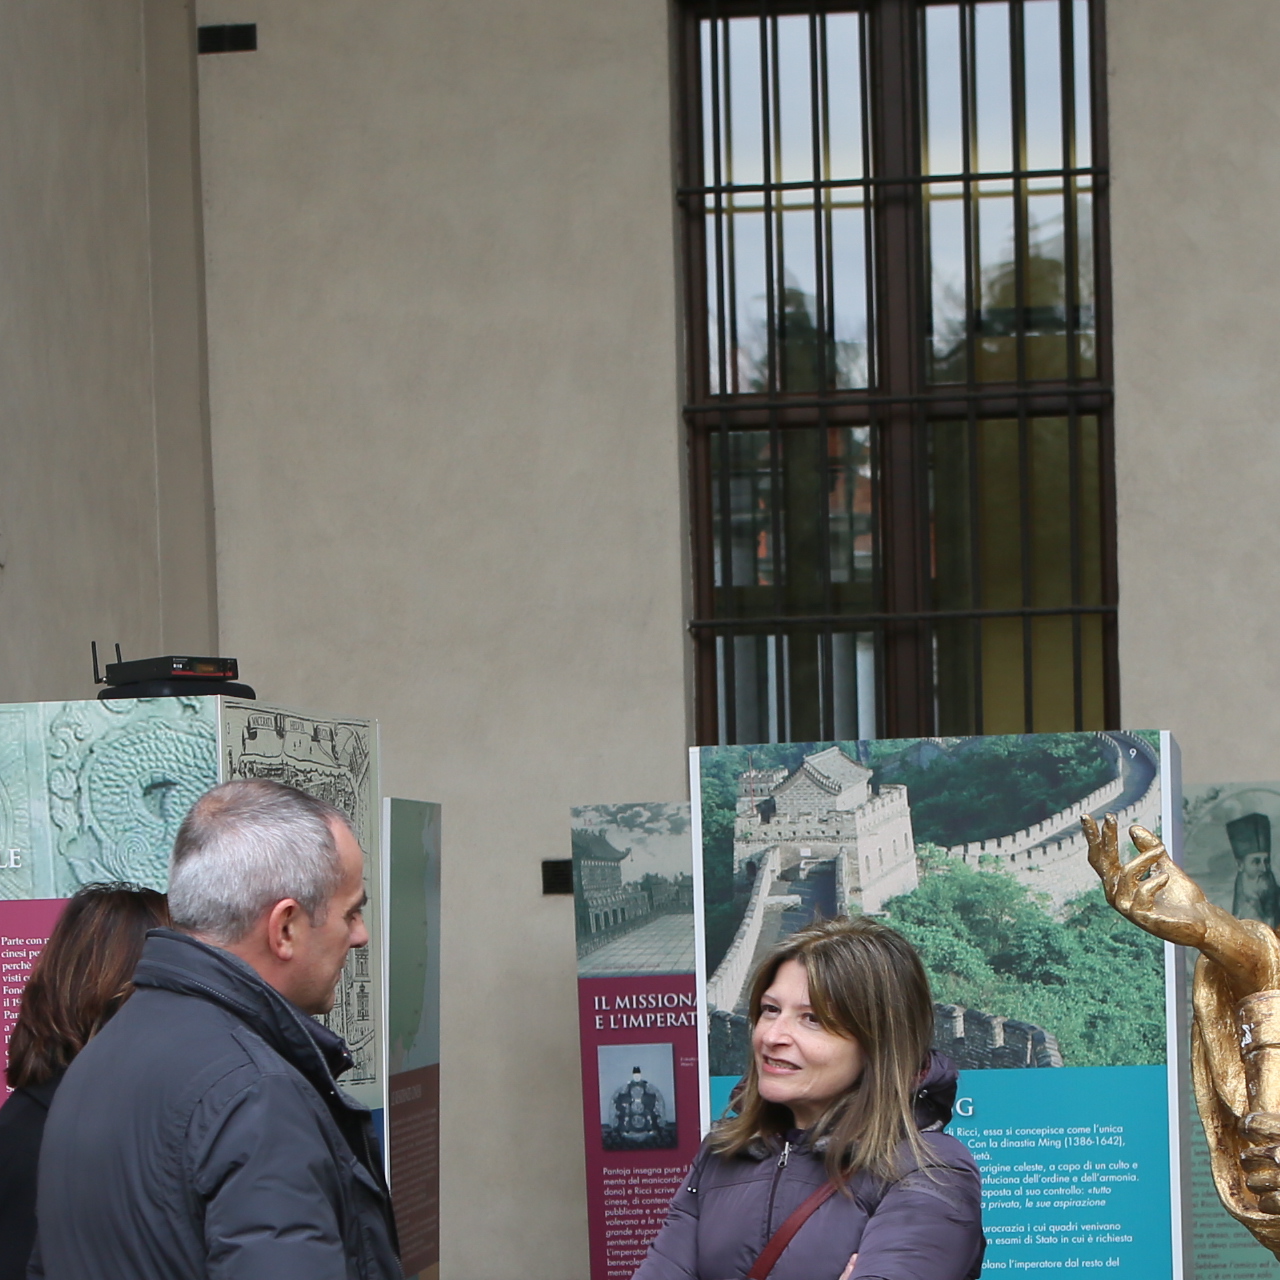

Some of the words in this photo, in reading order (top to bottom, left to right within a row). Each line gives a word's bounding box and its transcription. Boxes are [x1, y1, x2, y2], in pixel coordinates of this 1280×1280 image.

[1129, 747, 1137, 759] 9
[594, 996, 610, 1010] IL
[595, 1015, 604, 1029] E
[968, 1139, 986, 1148] Con
[989, 1138, 997, 1147] la
[1000, 1138, 1034, 1147] dinastia
[1038, 1137, 1060, 1148] Ming
[1064, 1136, 1124, 1147] (1386-1642),
[1009, 1259, 1061, 1269] l'imperatore
[1064, 1257, 1078, 1267] dal
[1082, 1259, 1102, 1267] resto
[1106, 1257, 1118, 1266] del
